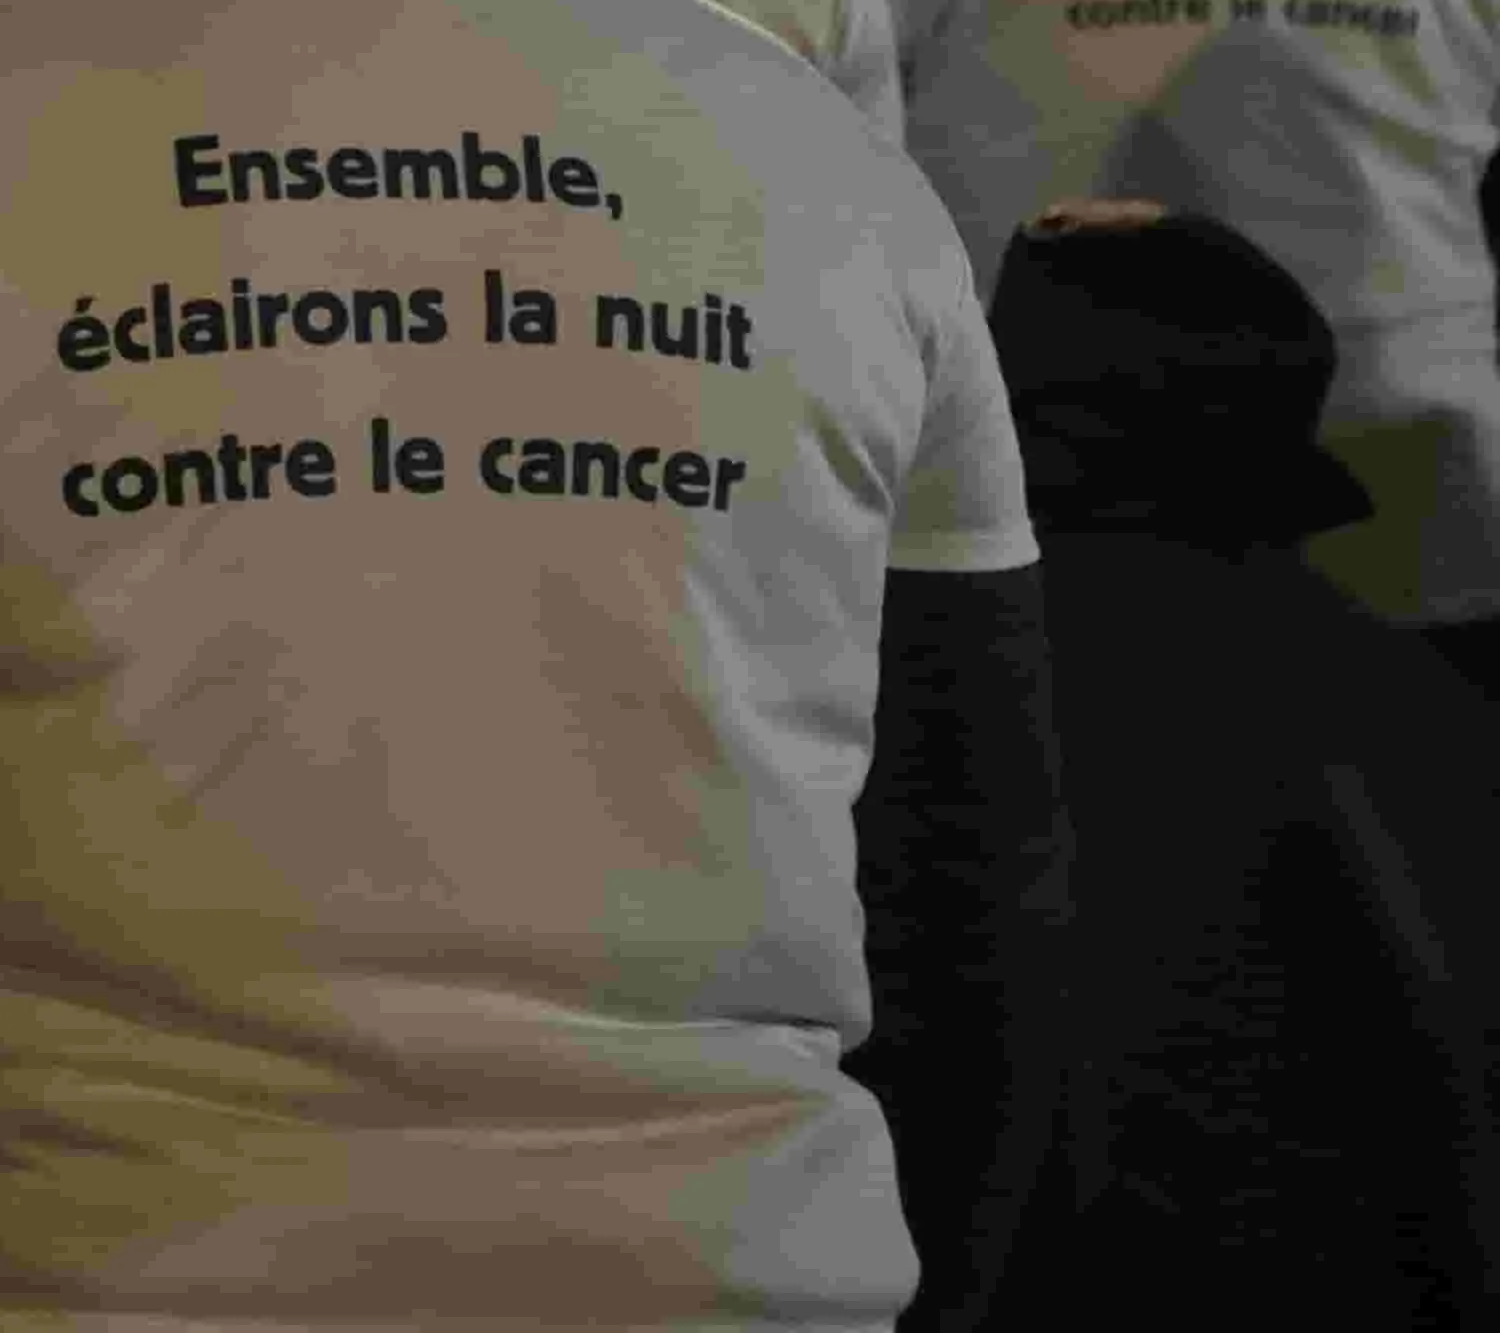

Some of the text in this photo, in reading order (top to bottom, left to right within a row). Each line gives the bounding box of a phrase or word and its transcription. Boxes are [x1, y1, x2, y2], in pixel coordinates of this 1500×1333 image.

[173, 132, 624, 221] Ensemble,
[56, 269, 753, 373] éclairons la nuit
[61, 416, 747, 518] contre le cancer
